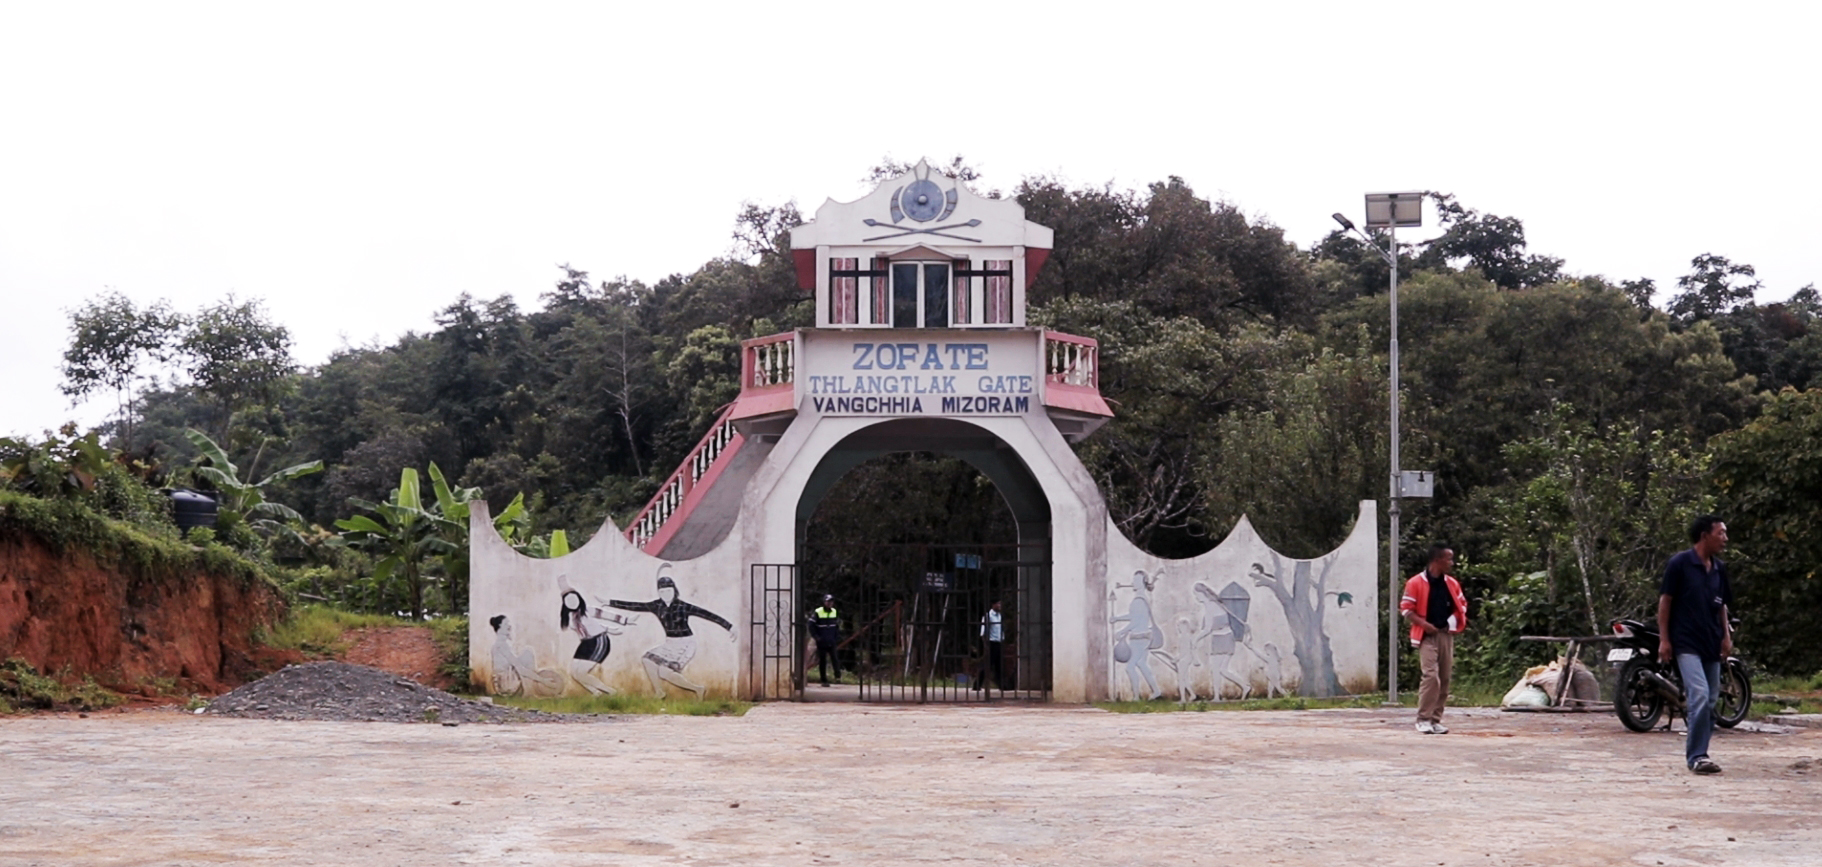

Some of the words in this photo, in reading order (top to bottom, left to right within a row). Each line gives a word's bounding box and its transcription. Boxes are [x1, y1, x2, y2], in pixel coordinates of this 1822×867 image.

[852, 343, 988, 370] ZOFATE
[809, 375, 957, 394] THLANGTLAK
[978, 375, 1033, 394] GATE
[812, 396, 923, 413] VANGCHHIA
[941, 396, 1029, 413] MIZORAM
